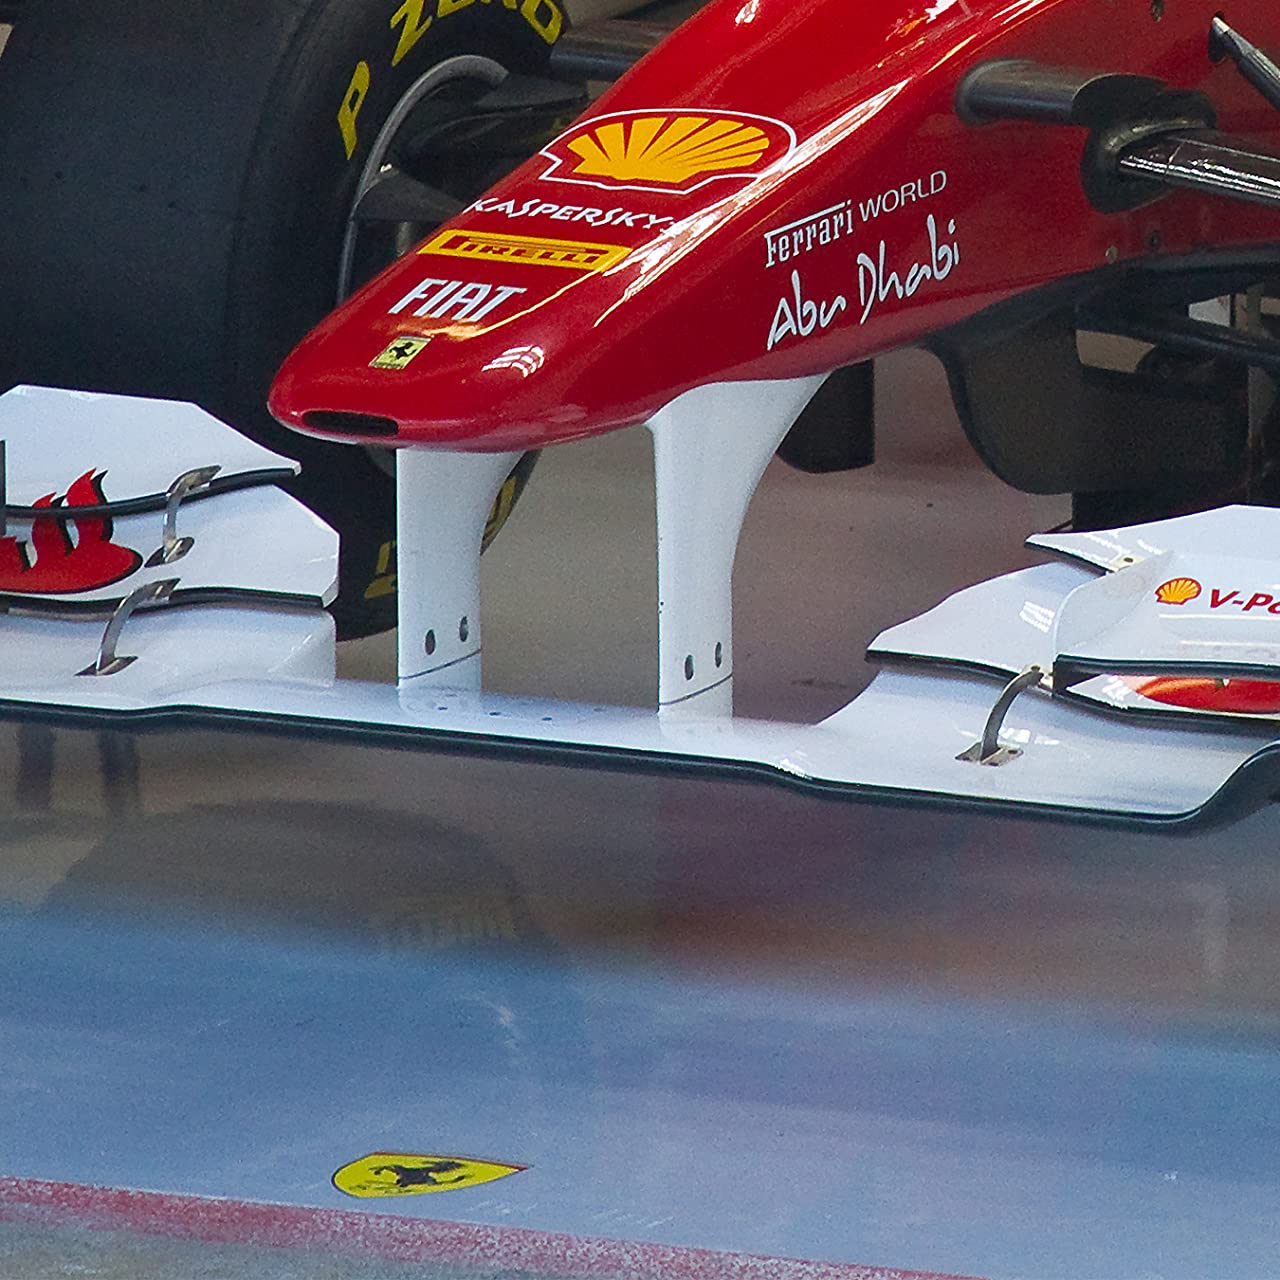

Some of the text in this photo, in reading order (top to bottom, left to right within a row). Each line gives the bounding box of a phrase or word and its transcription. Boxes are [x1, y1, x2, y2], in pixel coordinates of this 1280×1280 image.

[337, 60, 370, 160] P
[462, 197, 674, 229] KASPERSKY
[764, 170, 948, 268] Ferrari WORLD
[439, 234, 613, 264] PIRELLI
[767, 214, 960, 351] Abu Dhabi
[388, 277, 527, 322] FIAT
